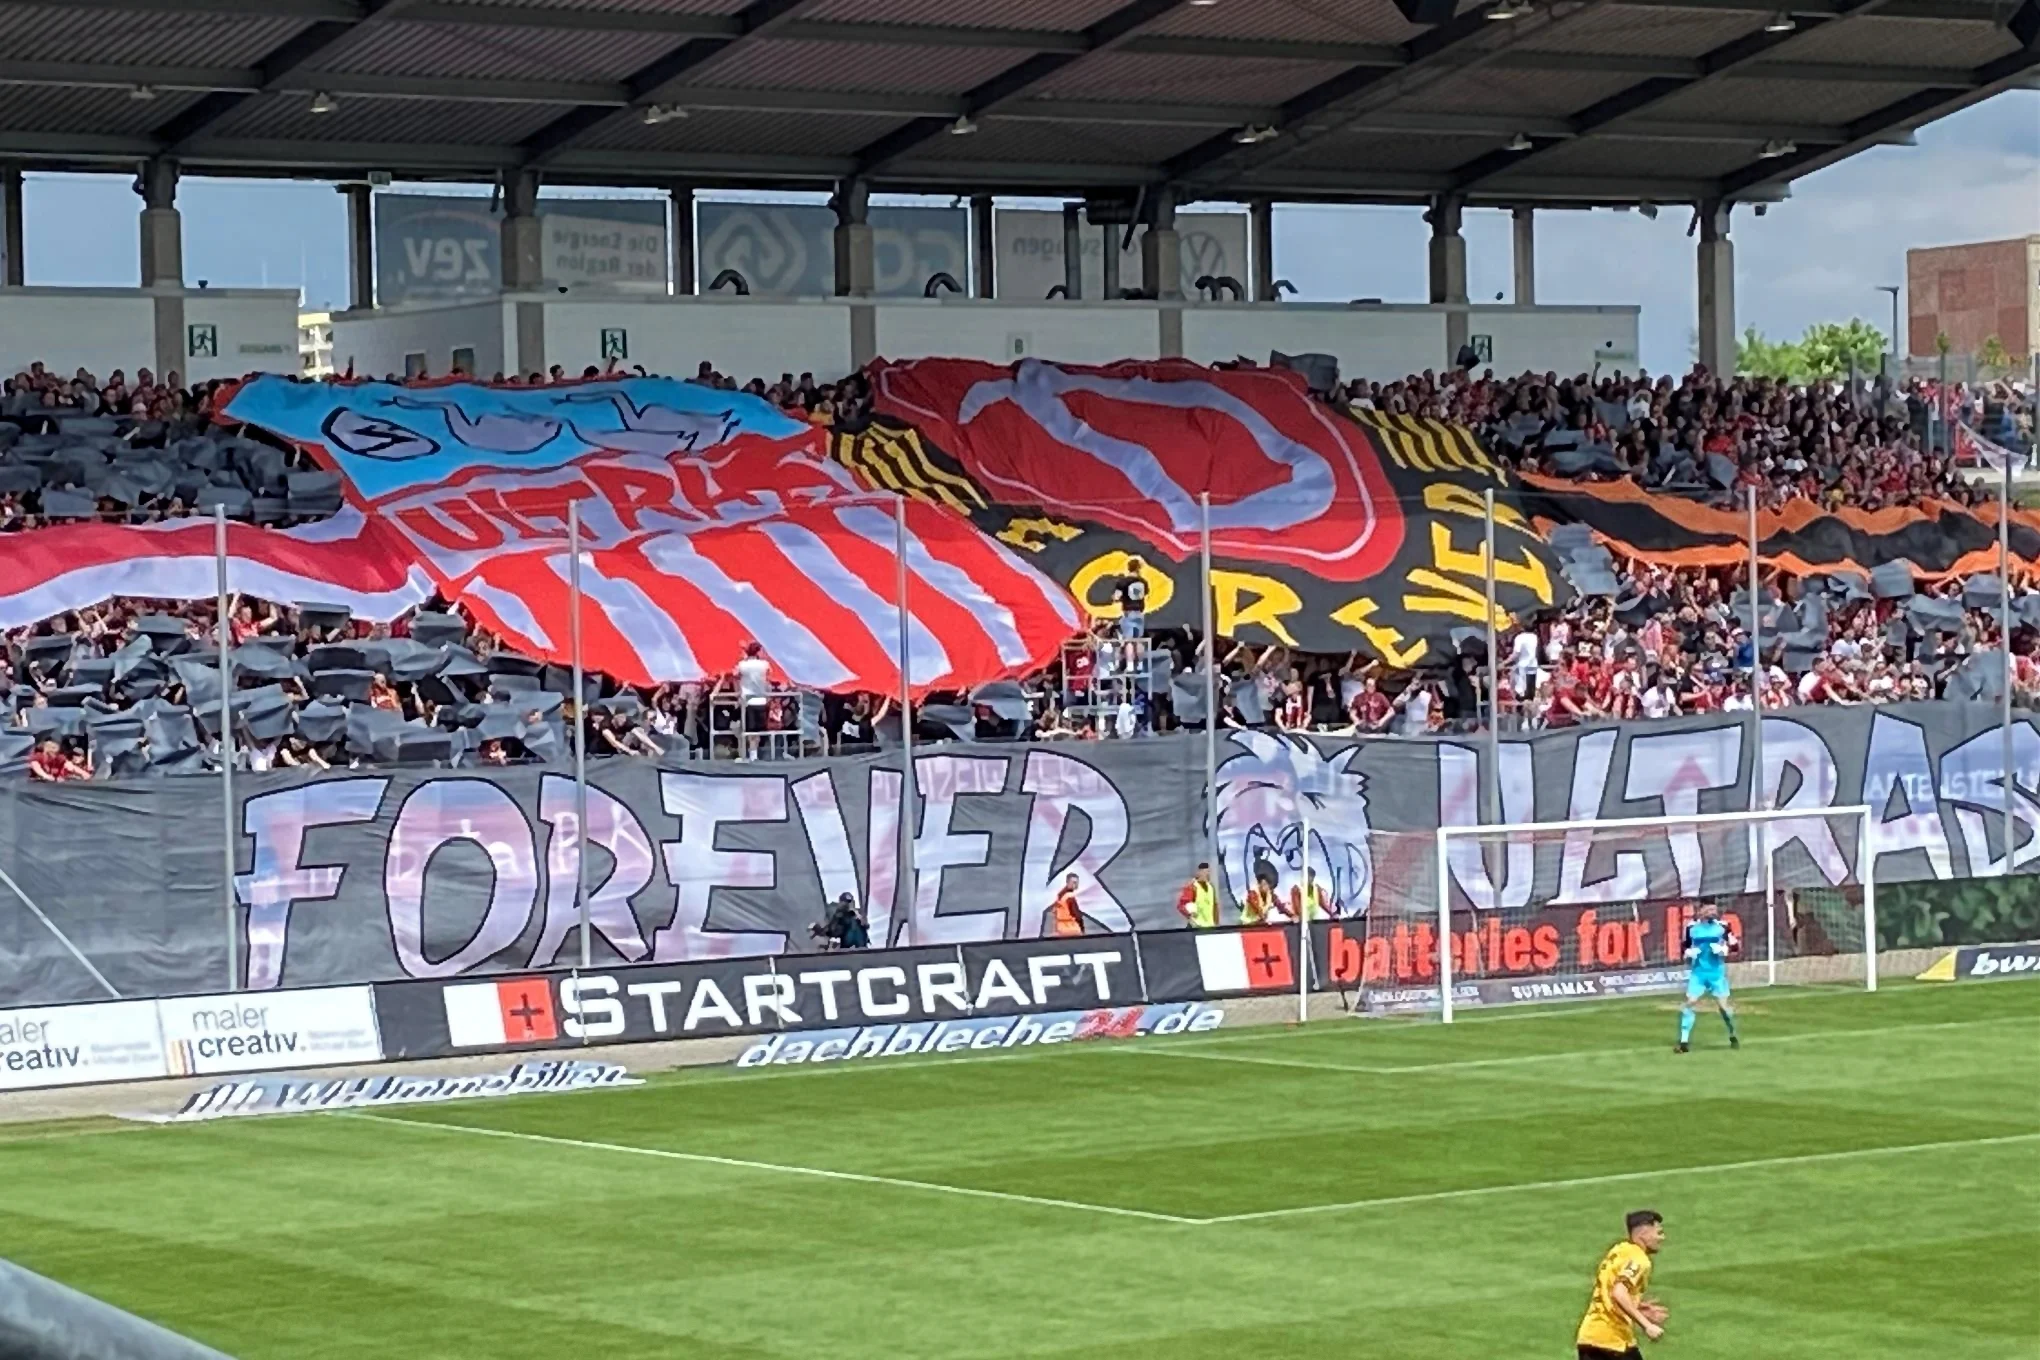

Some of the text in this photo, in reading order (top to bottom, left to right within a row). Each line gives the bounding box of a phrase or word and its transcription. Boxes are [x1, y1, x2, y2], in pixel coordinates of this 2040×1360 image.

[235, 711, 2040, 989] FOREVER ULTRAS
[1579, 909, 1649, 966] for
[192, 1003, 269, 1032] maler
[560, 950, 1122, 1038] STARTCRAFT
